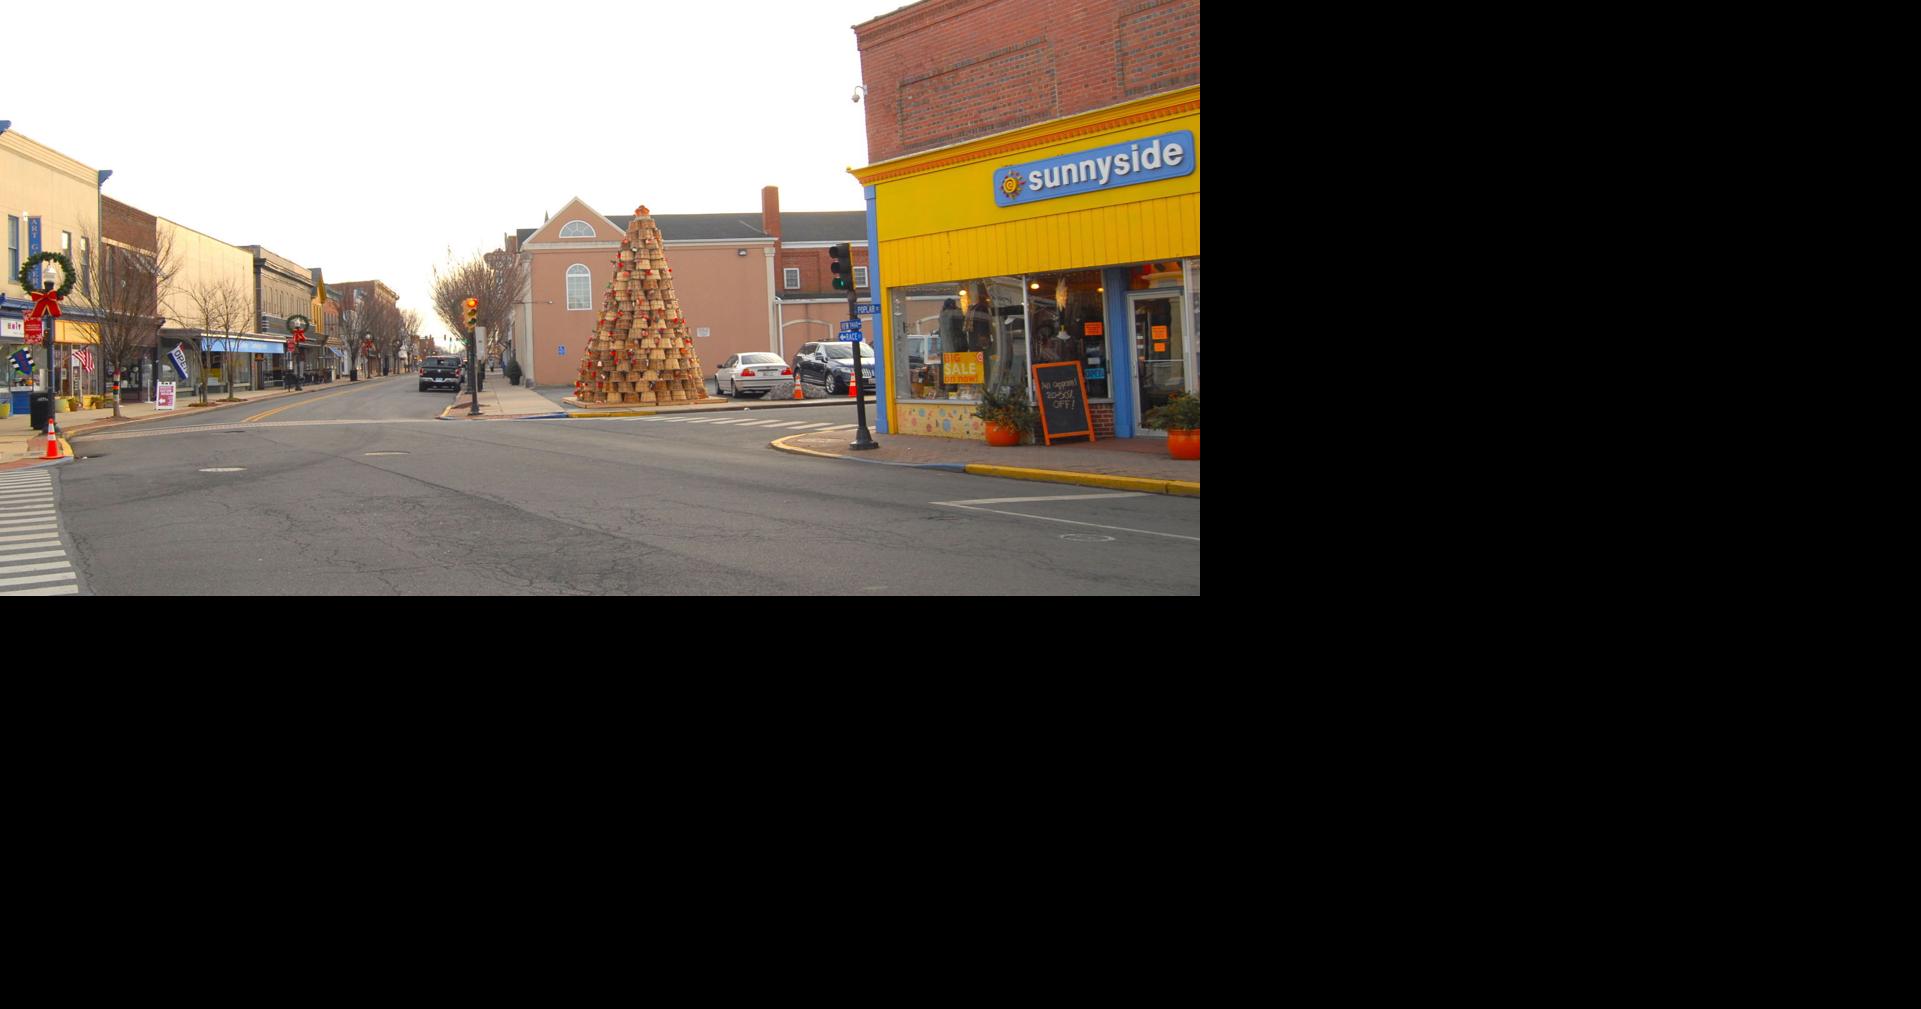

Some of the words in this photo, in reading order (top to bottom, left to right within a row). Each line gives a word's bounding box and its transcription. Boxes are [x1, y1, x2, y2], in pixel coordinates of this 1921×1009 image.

[1028, 139, 1184, 190] sunnyside
[857, 304, 875, 313] POPLAR
[846, 331, 858, 340] RACE
[944, 353, 960, 362] BIG
[944, 363, 976, 375] SALE
[1054, 400, 1075, 410] OFF!
